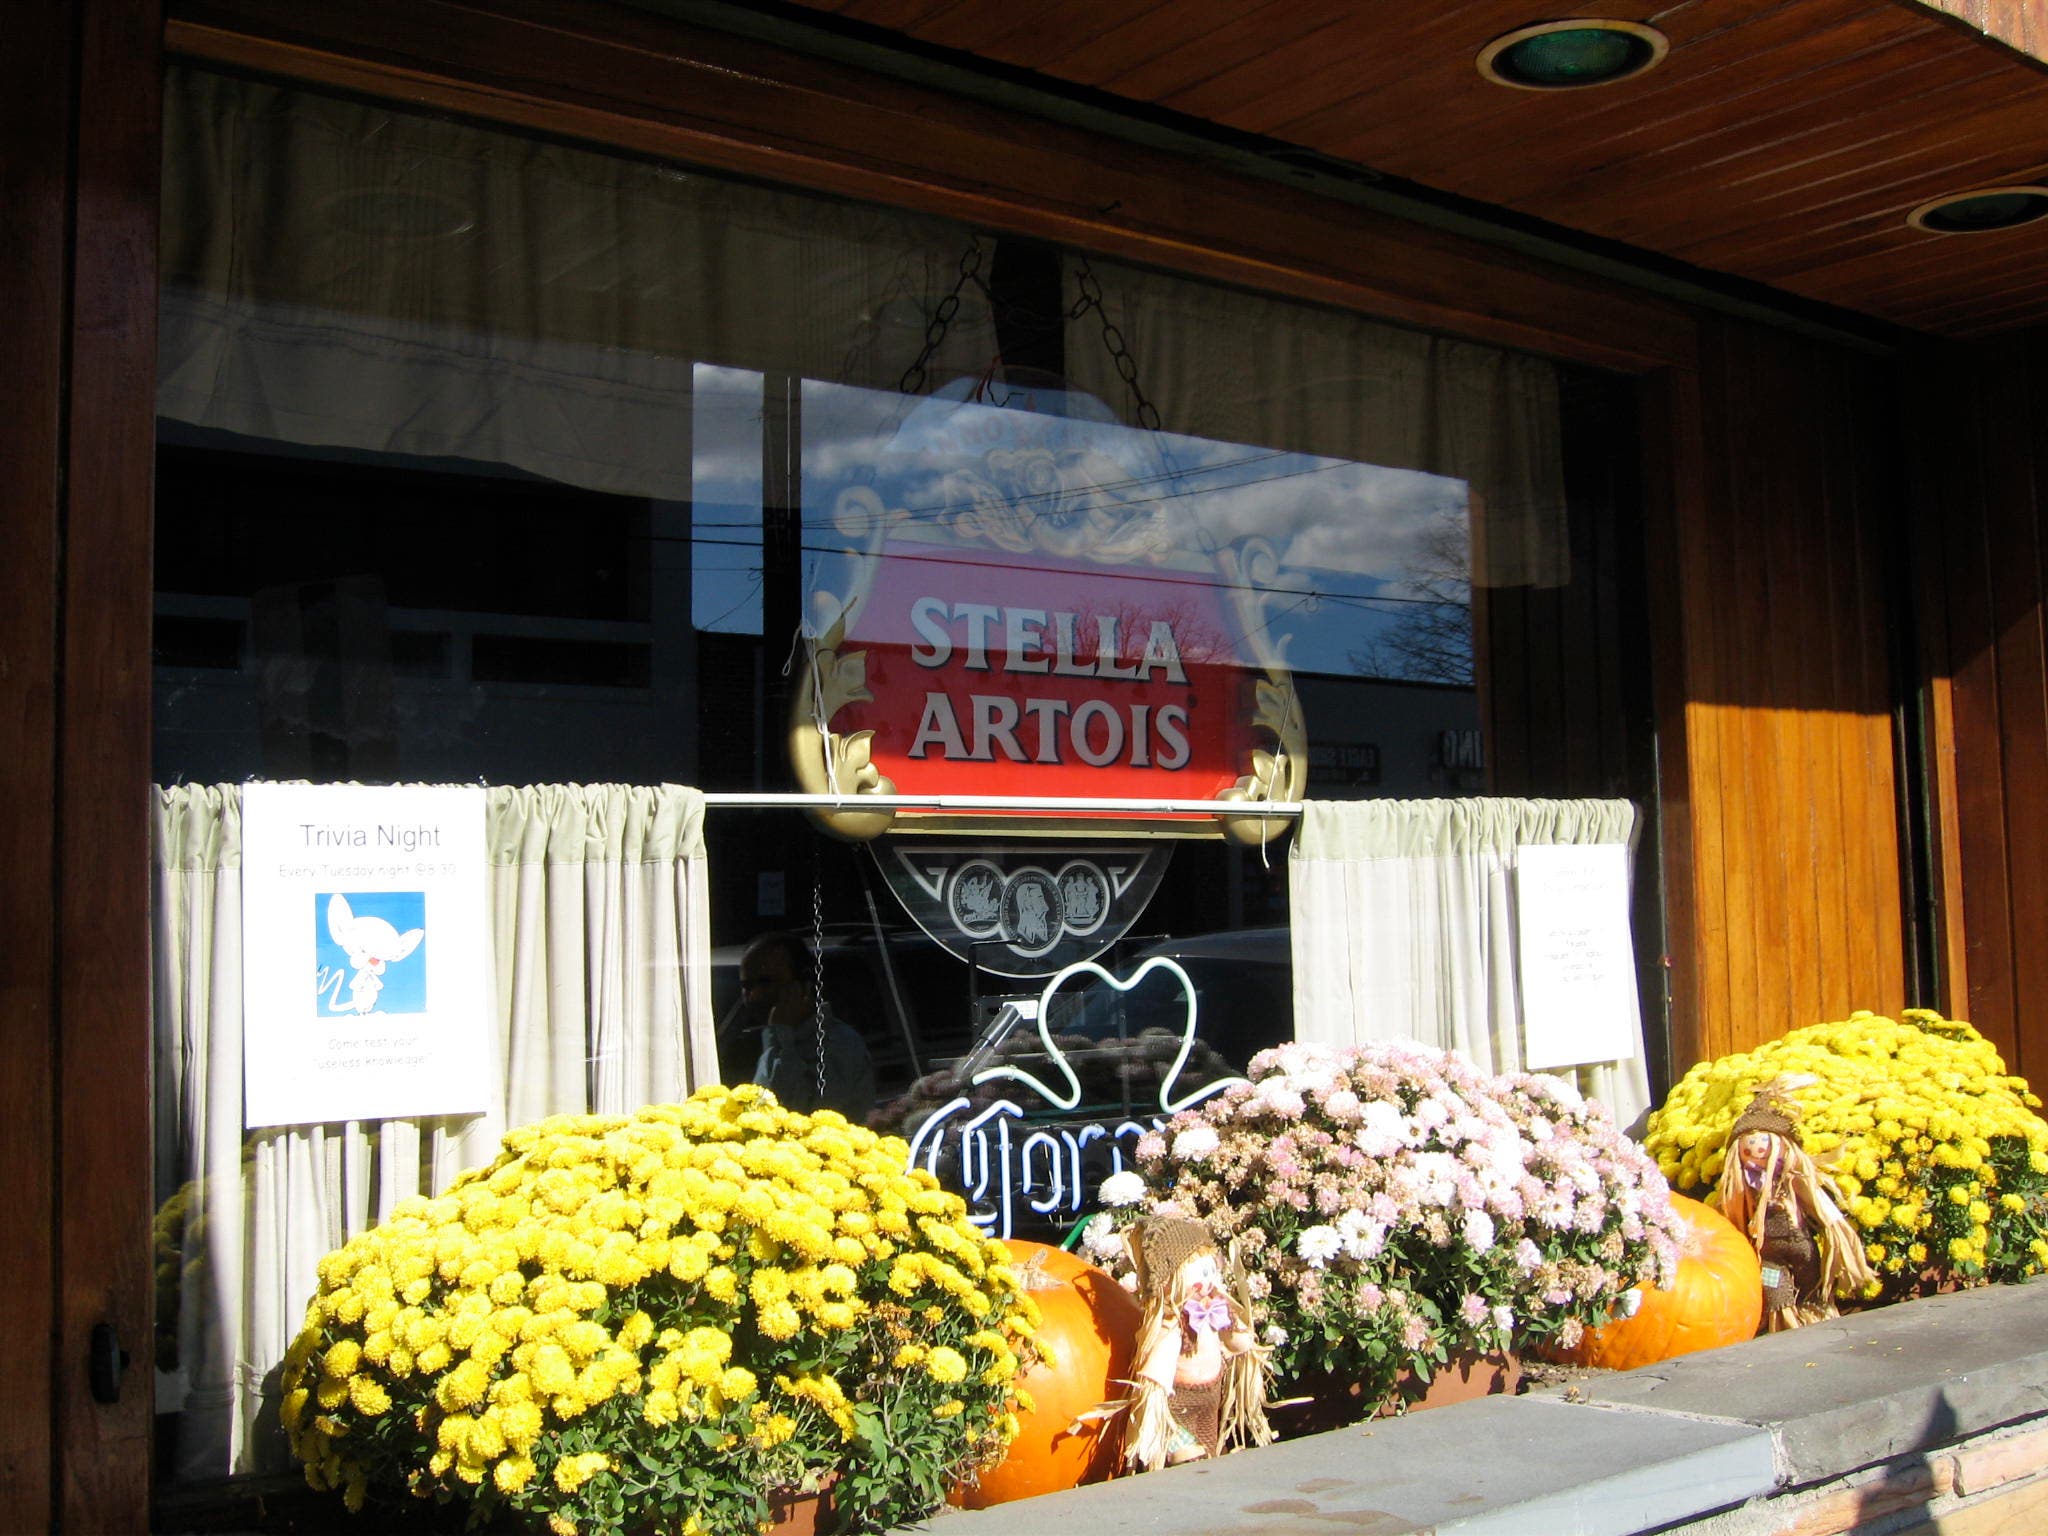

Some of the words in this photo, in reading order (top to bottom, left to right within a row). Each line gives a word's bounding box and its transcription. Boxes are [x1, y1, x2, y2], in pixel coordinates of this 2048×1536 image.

[910, 596, 1191, 684] STELLA
[907, 691, 1191, 772] ARTOIS
[299, 824, 367, 846] Trivia
[377, 824, 441, 852] Night
[279, 864, 316, 878] Every
[322, 864, 374, 878] Tuesday
[378, 864, 410, 879] night
